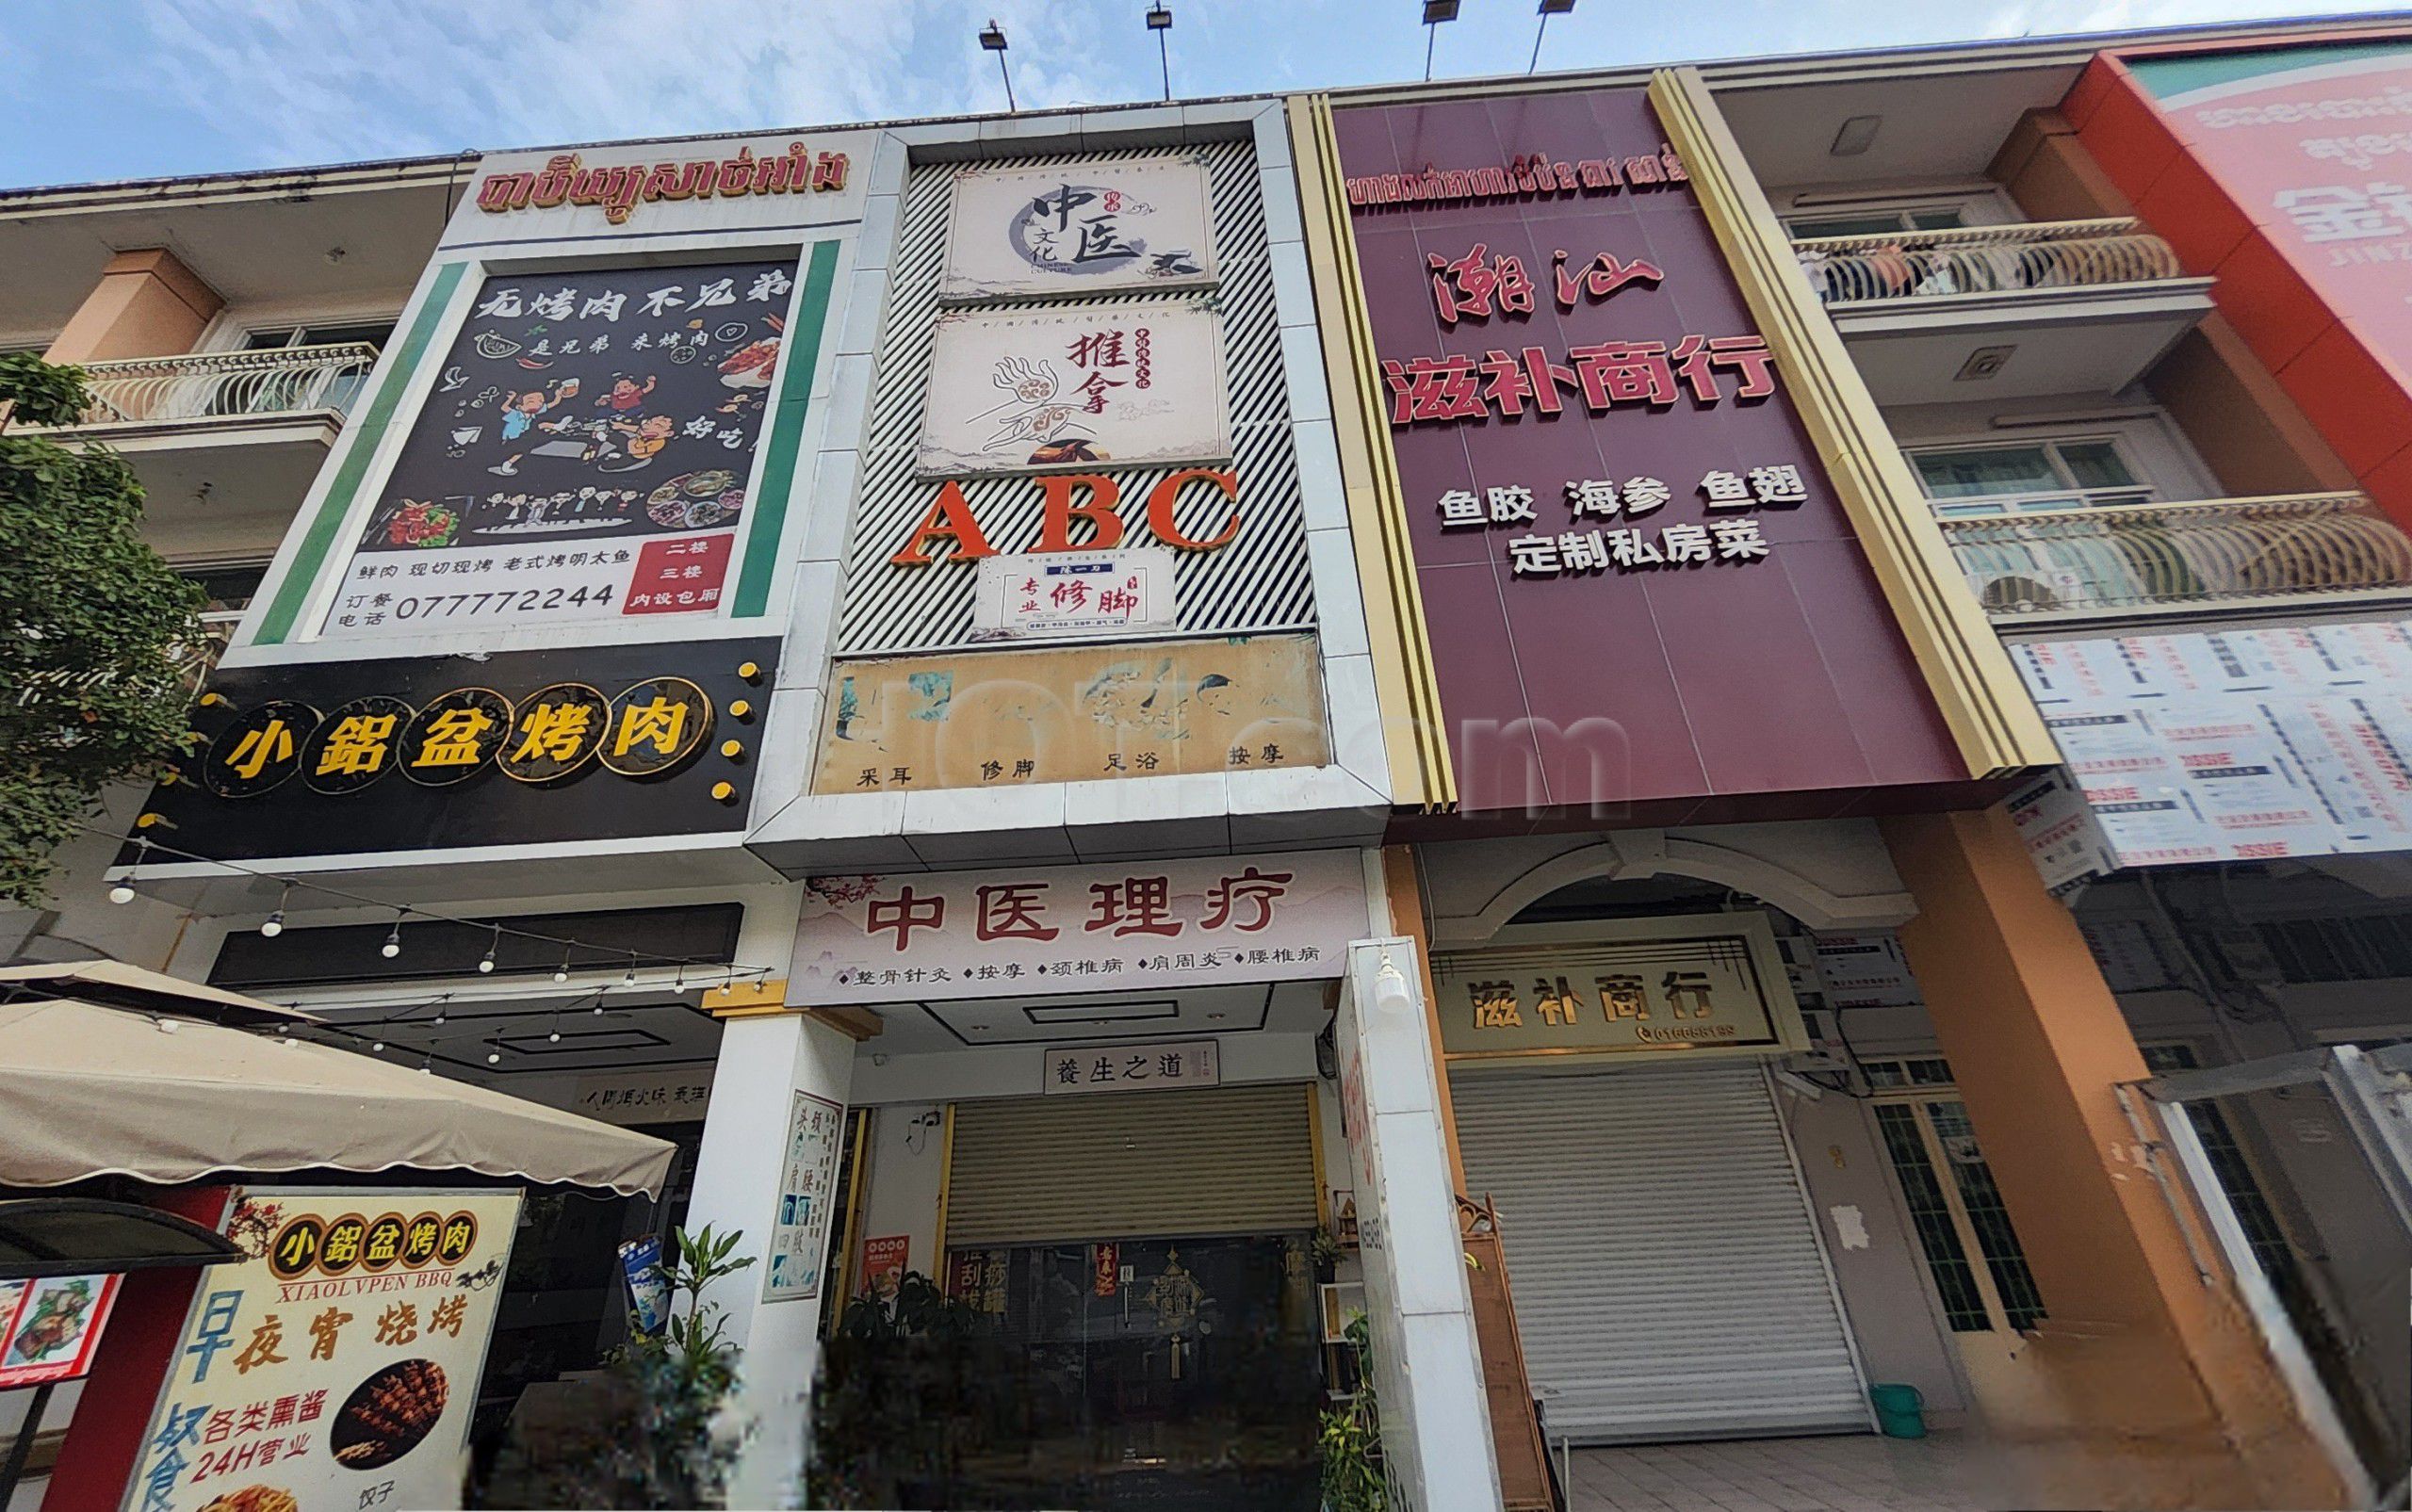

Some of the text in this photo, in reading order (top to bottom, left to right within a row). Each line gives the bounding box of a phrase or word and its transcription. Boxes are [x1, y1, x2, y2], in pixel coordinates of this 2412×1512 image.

[1031, 227, 1059, 262] 文化
[1428, 243, 1664, 323] 潮汕
[1067, 329, 1131, 415] 推拿
[1380, 334, 1775, 424] 滋补商行
[1438, 464, 1808, 529] 鱼胶 海参 鱼翅
[890, 469, 1241, 567] ABC
[356, 549, 632, 580] 鲜肉 现切现烤 老式烤明太鱼
[666, 542, 709, 556] 二楼
[1508, 518, 1770, 574] 定制私房菜
[660, 565, 703, 580] 三楼
[346, 593, 394, 610] 订餐
[396, 583, 614, 621] 077772244
[629, 588, 721, 609] 内设包厢
[1050, 578, 1138, 619] 修脚
[338, 611, 386, 628] 电话
[856, 743, 1284, 787] 采耳 修脚 足浴 按摩
[866, 867, 1293, 951] 中医理疗
[853, 946, 1321, 987] 整骨针灸 按摩 颈椎病 肩周炎 腰椎病
[1468, 970, 1715, 1029] 滋补商行
[1056, 1052, 1183, 1084] 養生之道
[415, 1270, 453, 1290] BBQ
[202, 1389, 329, 1446] 各类熏酱
[190, 1432, 311, 1485] 24H营业
